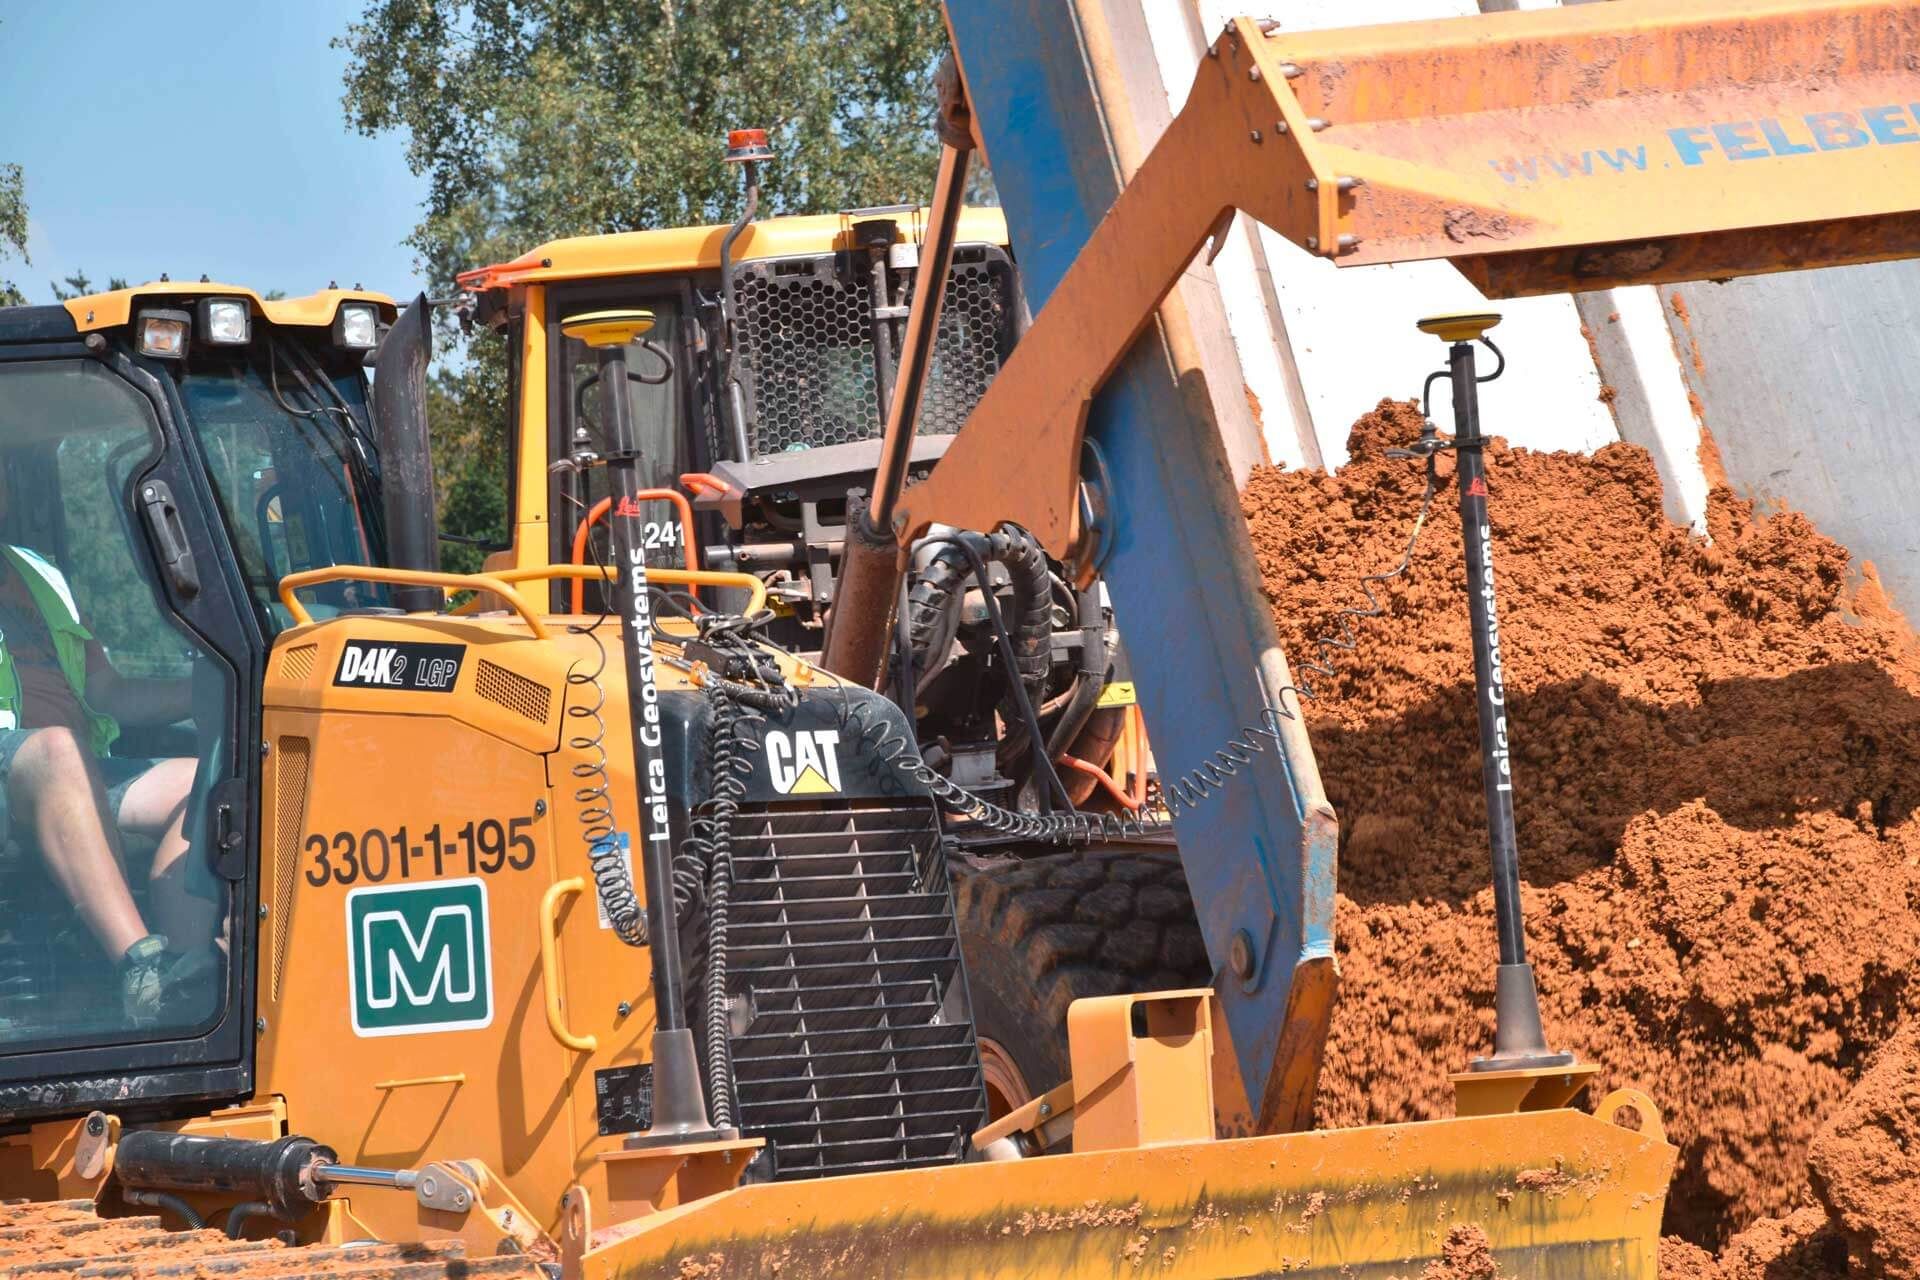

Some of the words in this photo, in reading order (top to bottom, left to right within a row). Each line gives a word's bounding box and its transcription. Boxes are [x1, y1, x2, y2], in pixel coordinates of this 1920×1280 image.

[415, 658, 457, 687] LGP
[630, 547, 662, 747] Geosystems
[645, 758, 669, 841] Leica
[765, 730, 842, 795] CAT
[305, 816, 536, 887] 3301-1-195
[363, 904, 476, 1009] M
